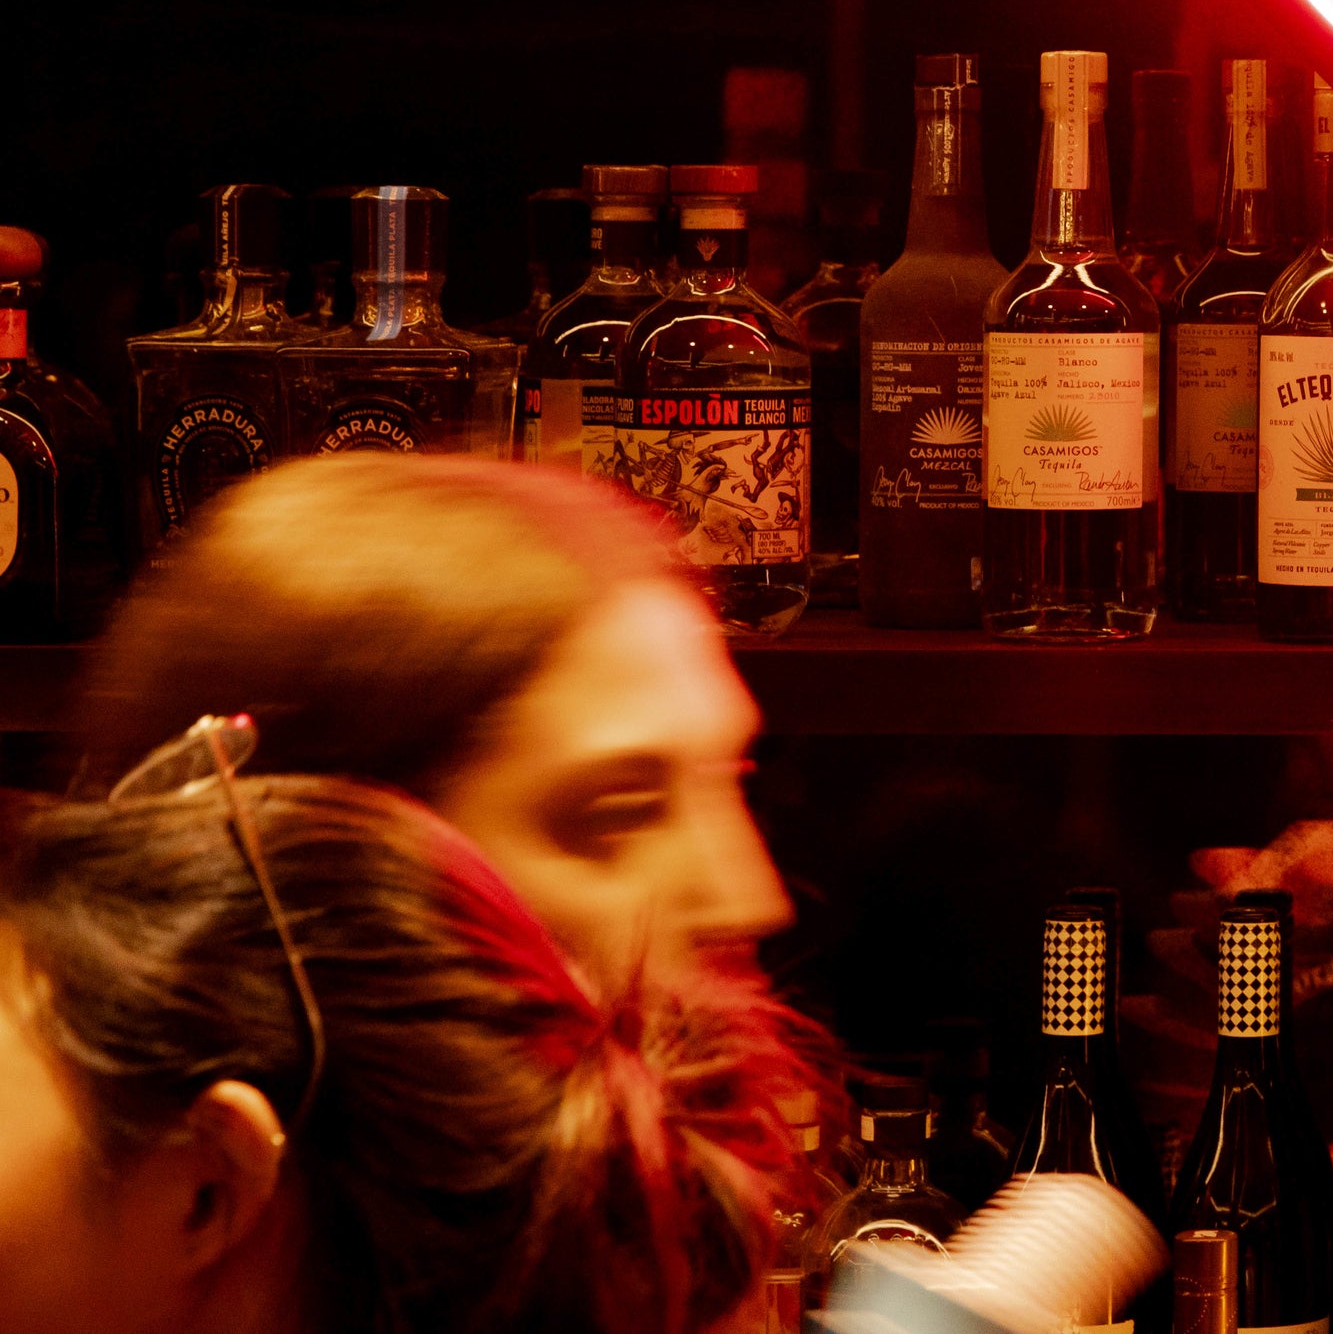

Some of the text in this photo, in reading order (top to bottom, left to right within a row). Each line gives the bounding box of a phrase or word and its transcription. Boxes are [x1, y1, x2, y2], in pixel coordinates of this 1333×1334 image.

[1318, 116, 1330, 135] EL
[386, 210, 397, 285] TEQUILA PLATA
[932, 342, 945, 351] DE
[1038, 337, 1140, 345] CASAMIGOS DE AGAVE
[1058, 357, 1098, 367] Blanco
[1024, 375, 1048, 389] 100%
[1057, 379, 1141, 389] Jalisco, Mexico
[1277, 382, 1298, 408] EL
[744, 398, 786, 413] TEQUILA
[744, 412, 786, 426] BLANCO
[162, 407, 264, 452] HERRADURA
[320, 419, 414, 457] HERRADUR
[909, 447, 983, 459] CASAMIGOS
[1023, 445, 1100, 456] CASAMIGOS
[920, 460, 973, 471] MEZCAL
[1039, 459, 1083, 473] Tequila
[159, 467, 177, 521] TEQUILA
[757, 532, 771, 541] 700
[1276, 564, 1305, 573] HECHO EN
